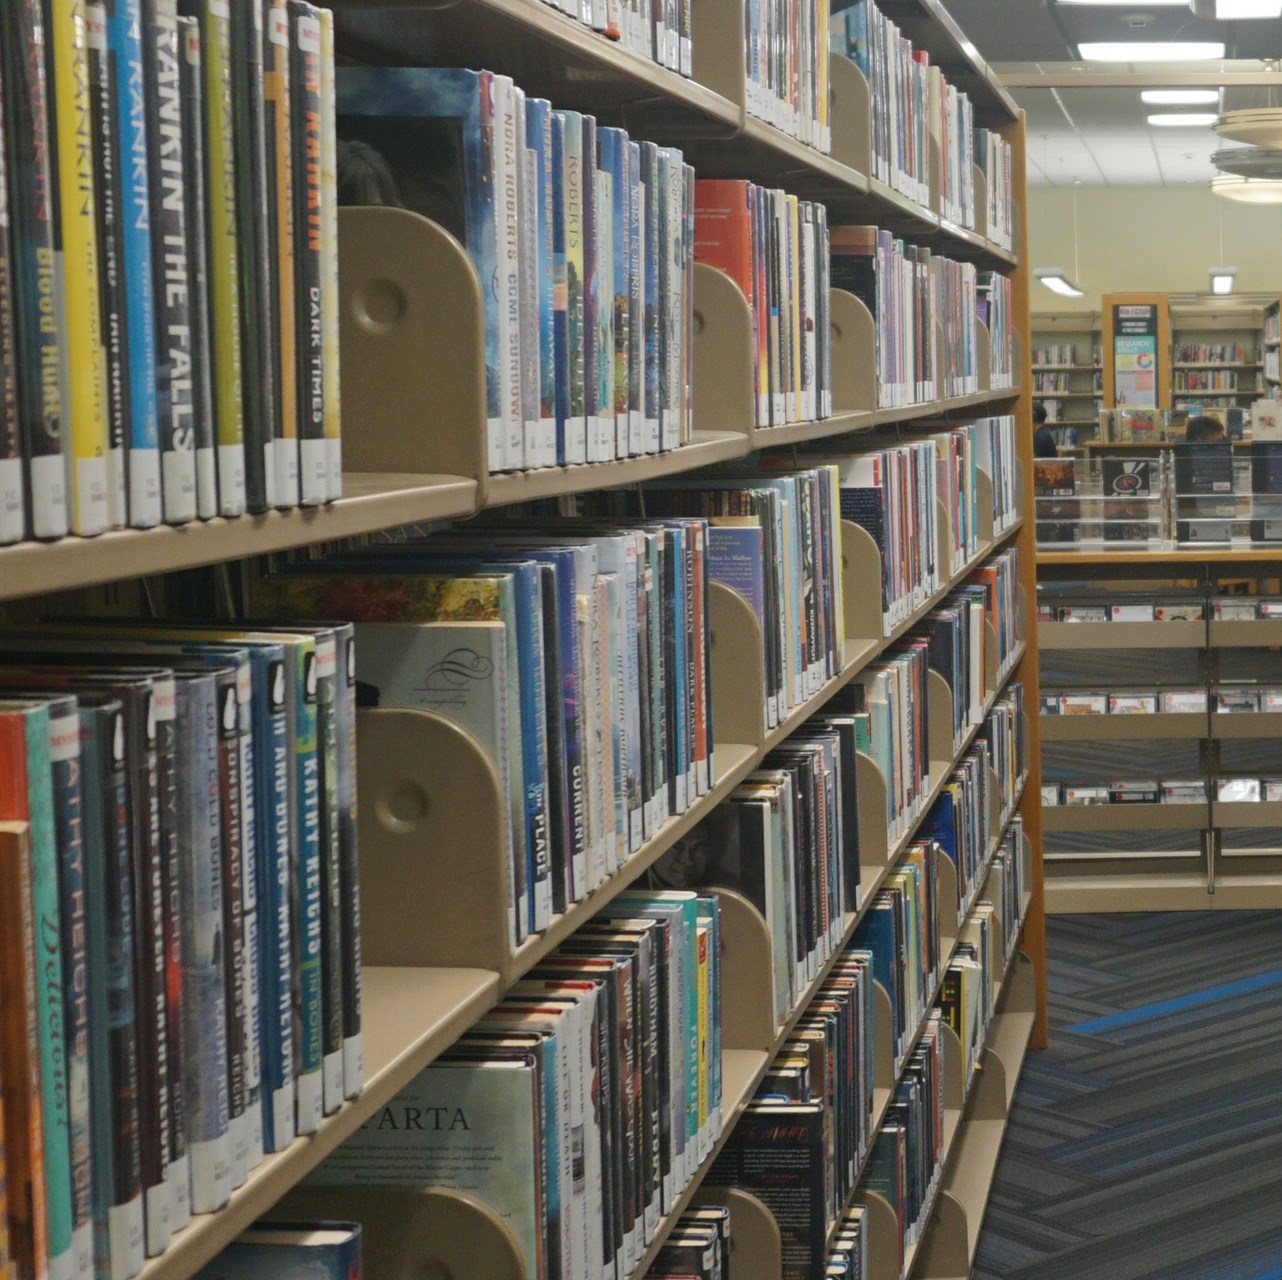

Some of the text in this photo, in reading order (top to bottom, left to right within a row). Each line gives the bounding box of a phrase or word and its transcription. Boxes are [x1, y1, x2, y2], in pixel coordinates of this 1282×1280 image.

[128, 60, 150, 230] RANKIN
[156, 26, 195, 453] RANKIN THE FALLS
[504, 112, 522, 422] NORA ROBERTS COME SUNDOW
[569, 155, 585, 402] ROBERTS IDENTITY
[35, 246, 62, 418] Blood Hunt
[309, 286, 322, 348] DARK
[311, 356, 324, 424] TIMES
[686, 550, 694, 634] ROBINSON
[274, 746, 288, 792] AND
[304, 756, 319, 843] KATHY
[572, 765, 584, 849] CURRENT
[67, 759, 82, 871] ATHY
[535, 814, 547, 876] PLACE
[306, 856, 321, 955] REICHS
[308, 1000, 322, 1064] BONES
[361, 1107, 471, 1131] ARTA
